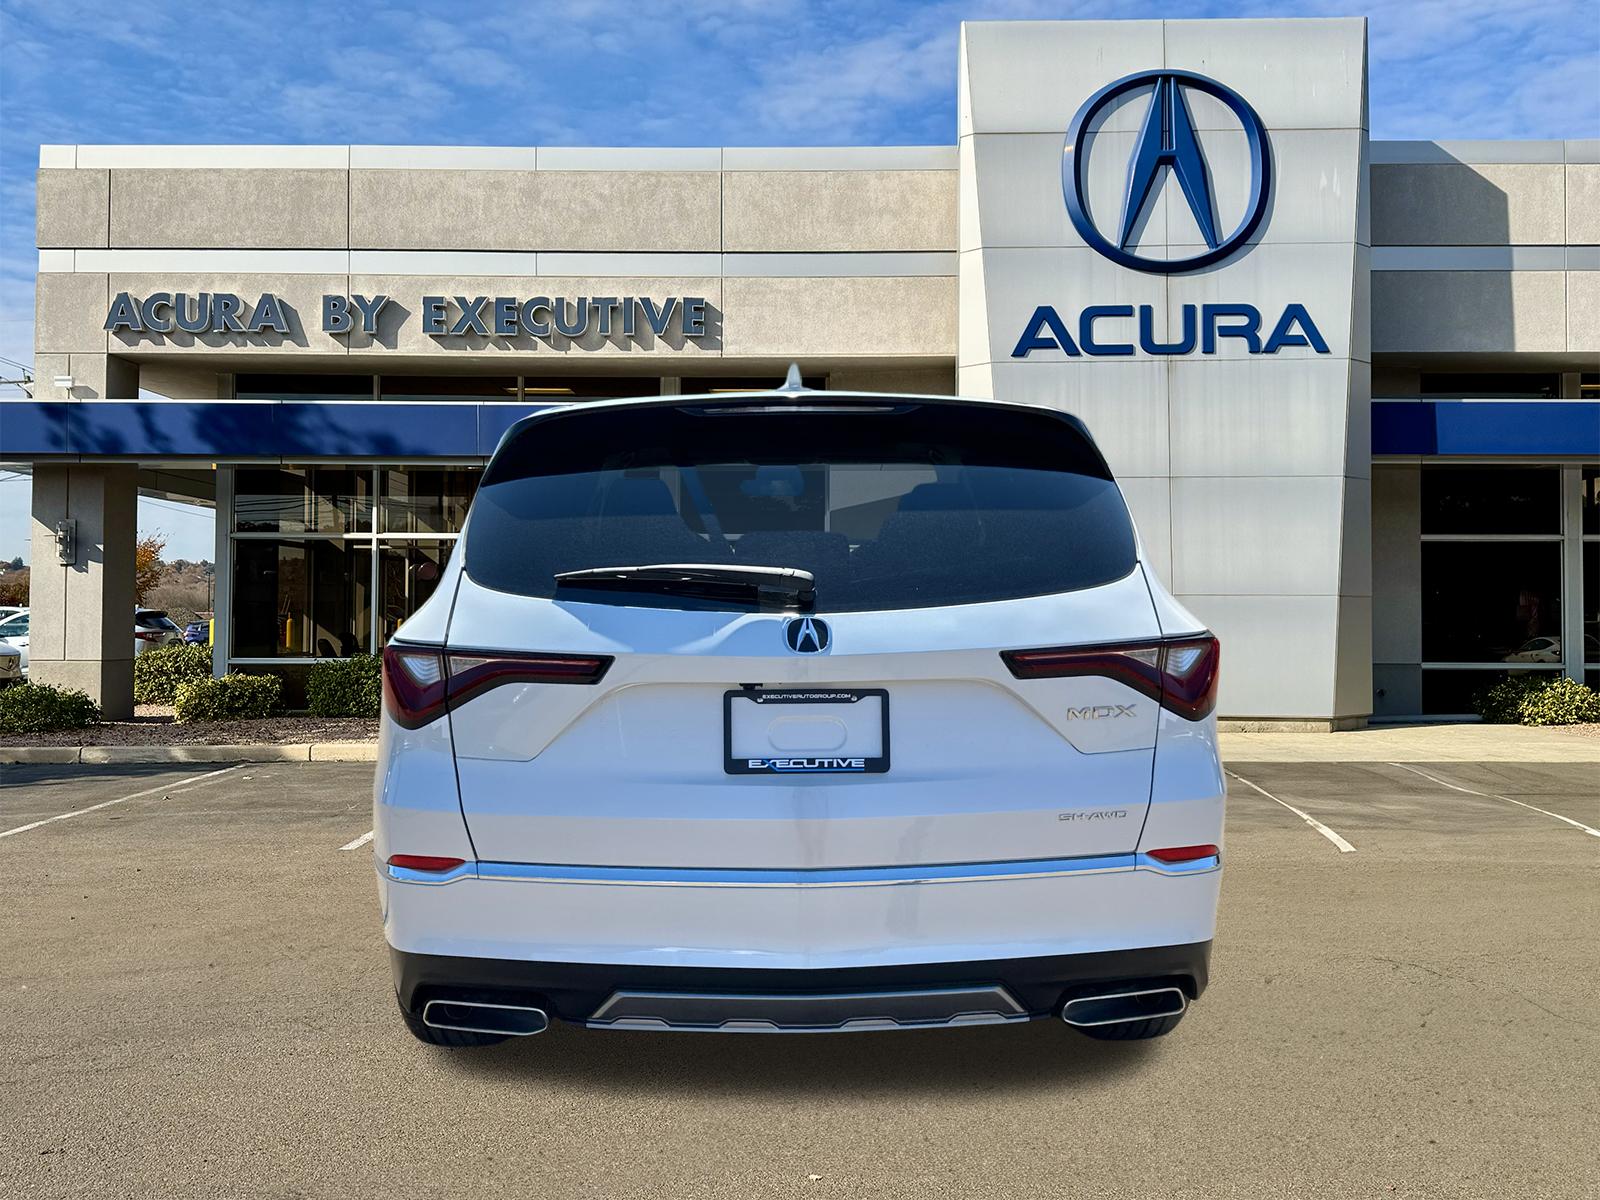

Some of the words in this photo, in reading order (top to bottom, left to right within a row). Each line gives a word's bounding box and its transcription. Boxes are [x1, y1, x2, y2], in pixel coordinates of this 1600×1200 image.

[104, 291, 291, 334] ACURA
[321, 293, 390, 335] BY
[422, 295, 707, 338] EXECUTIVE
[1011, 303, 1332, 357] ACURA
[1067, 703, 1137, 720] MDX
[748, 758, 865, 770] EXECUTIVE
